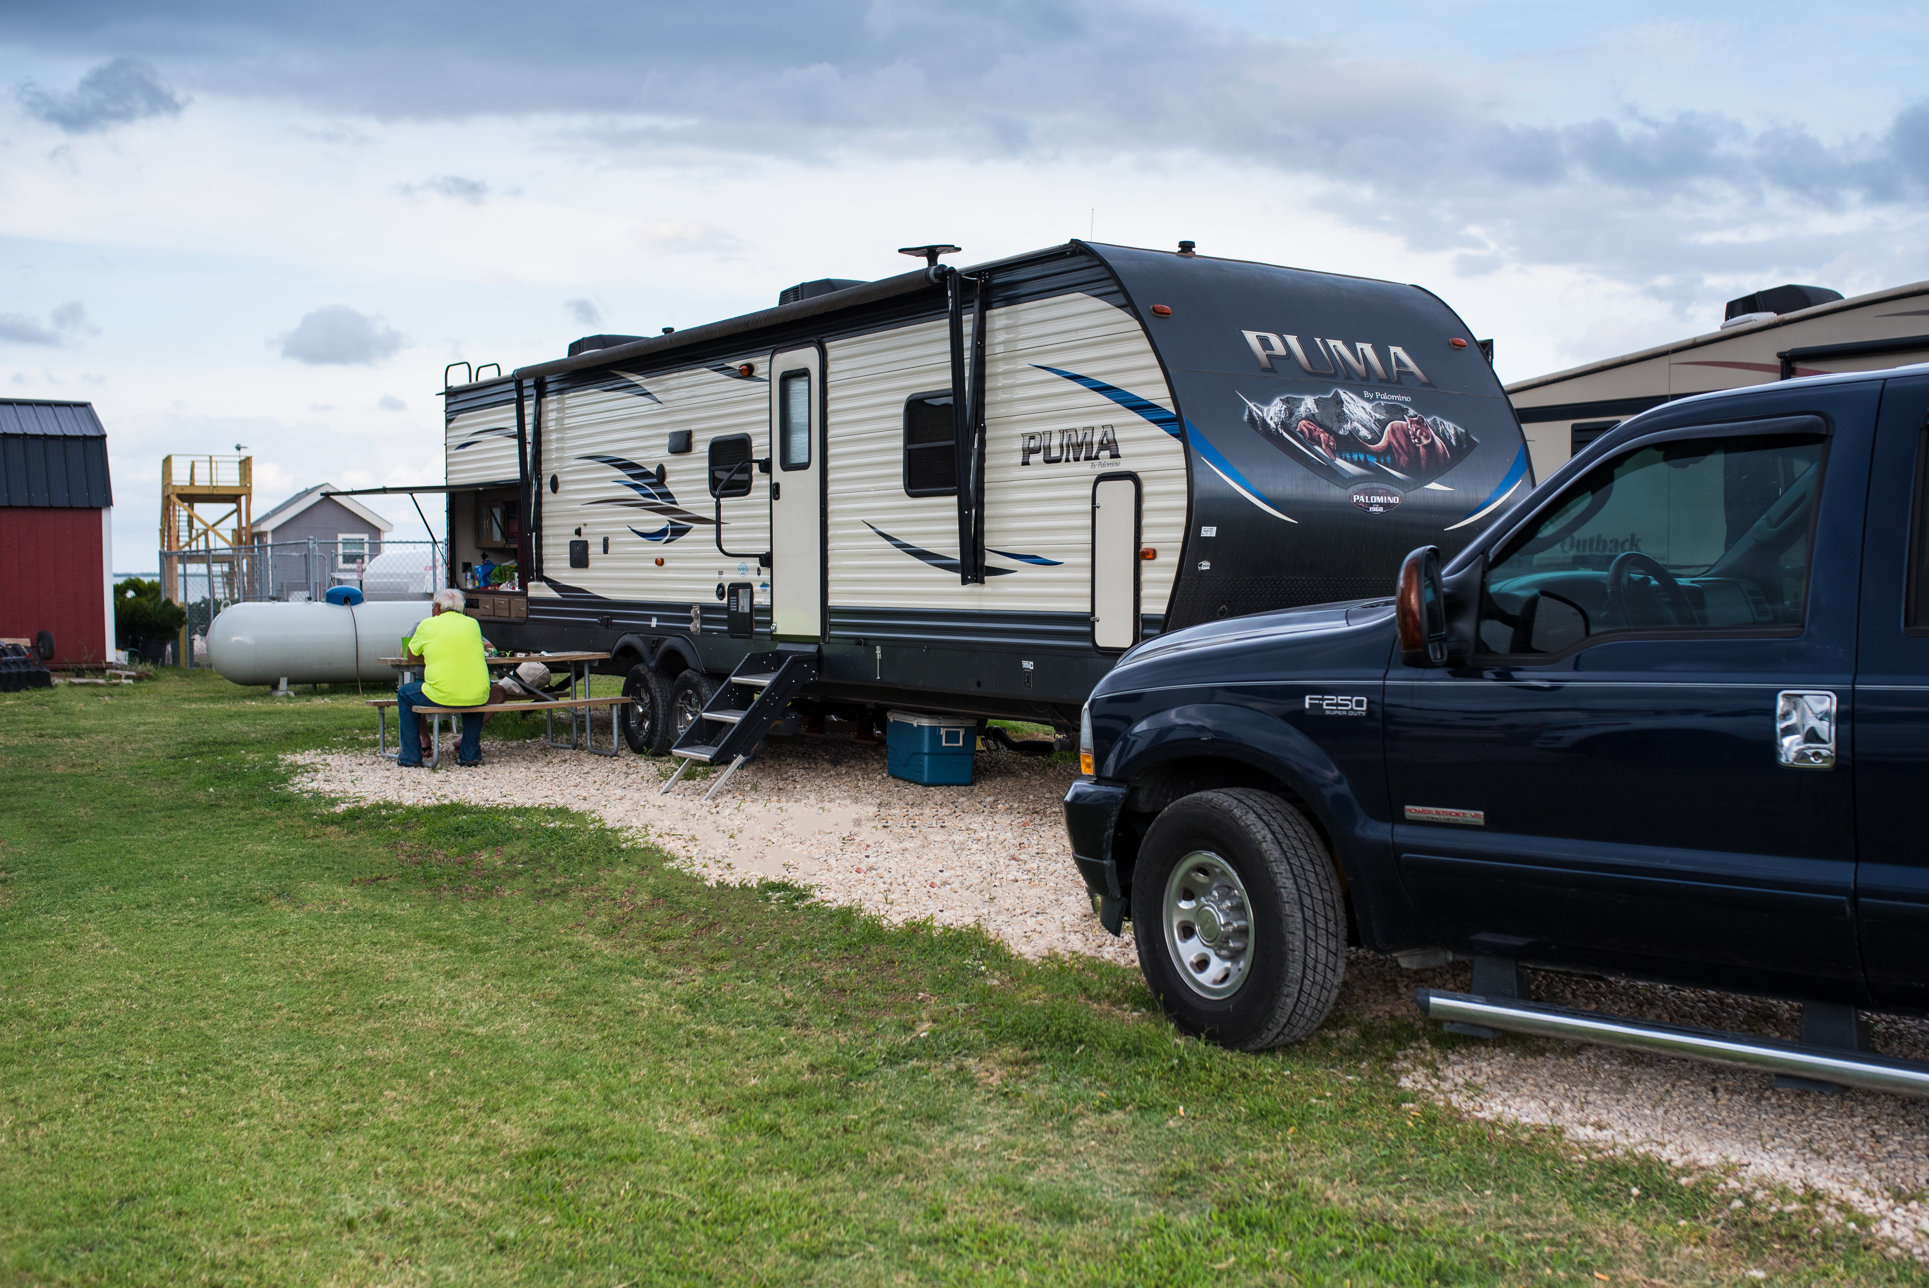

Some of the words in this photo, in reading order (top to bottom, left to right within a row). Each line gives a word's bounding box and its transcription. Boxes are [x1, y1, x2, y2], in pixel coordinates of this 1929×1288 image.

[1241, 330, 1434, 386] PUMA
[1363, 390, 1374, 400] By
[1375, 391, 1412, 402] Palomino
[1021, 424, 1122, 466] PUMA
[1353, 494, 1400, 504] PALOMINO
[1560, 532, 1643, 553] Outback
